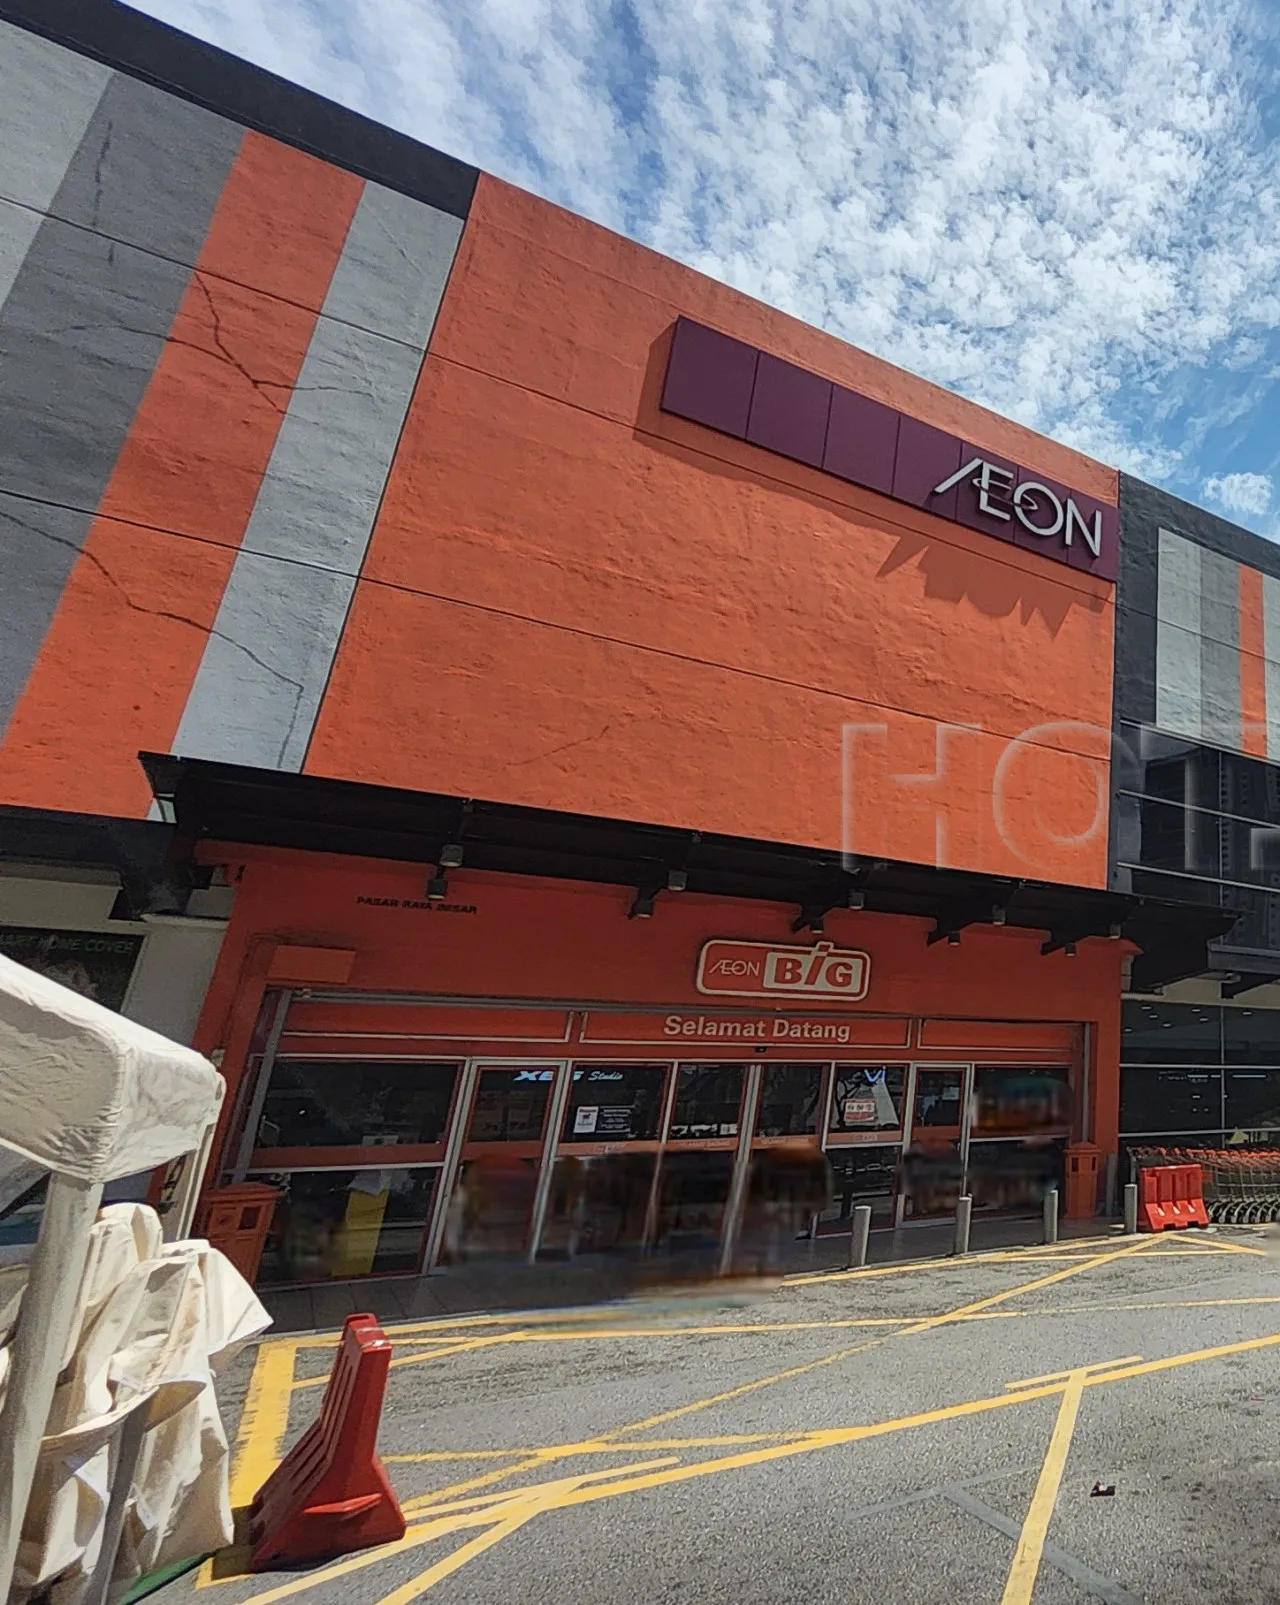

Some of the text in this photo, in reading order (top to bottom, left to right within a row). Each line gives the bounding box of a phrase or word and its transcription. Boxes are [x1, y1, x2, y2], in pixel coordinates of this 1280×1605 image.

[357, 896, 398, 908] PASAR
[663, 1015, 851, 1043] Selamat Datang
